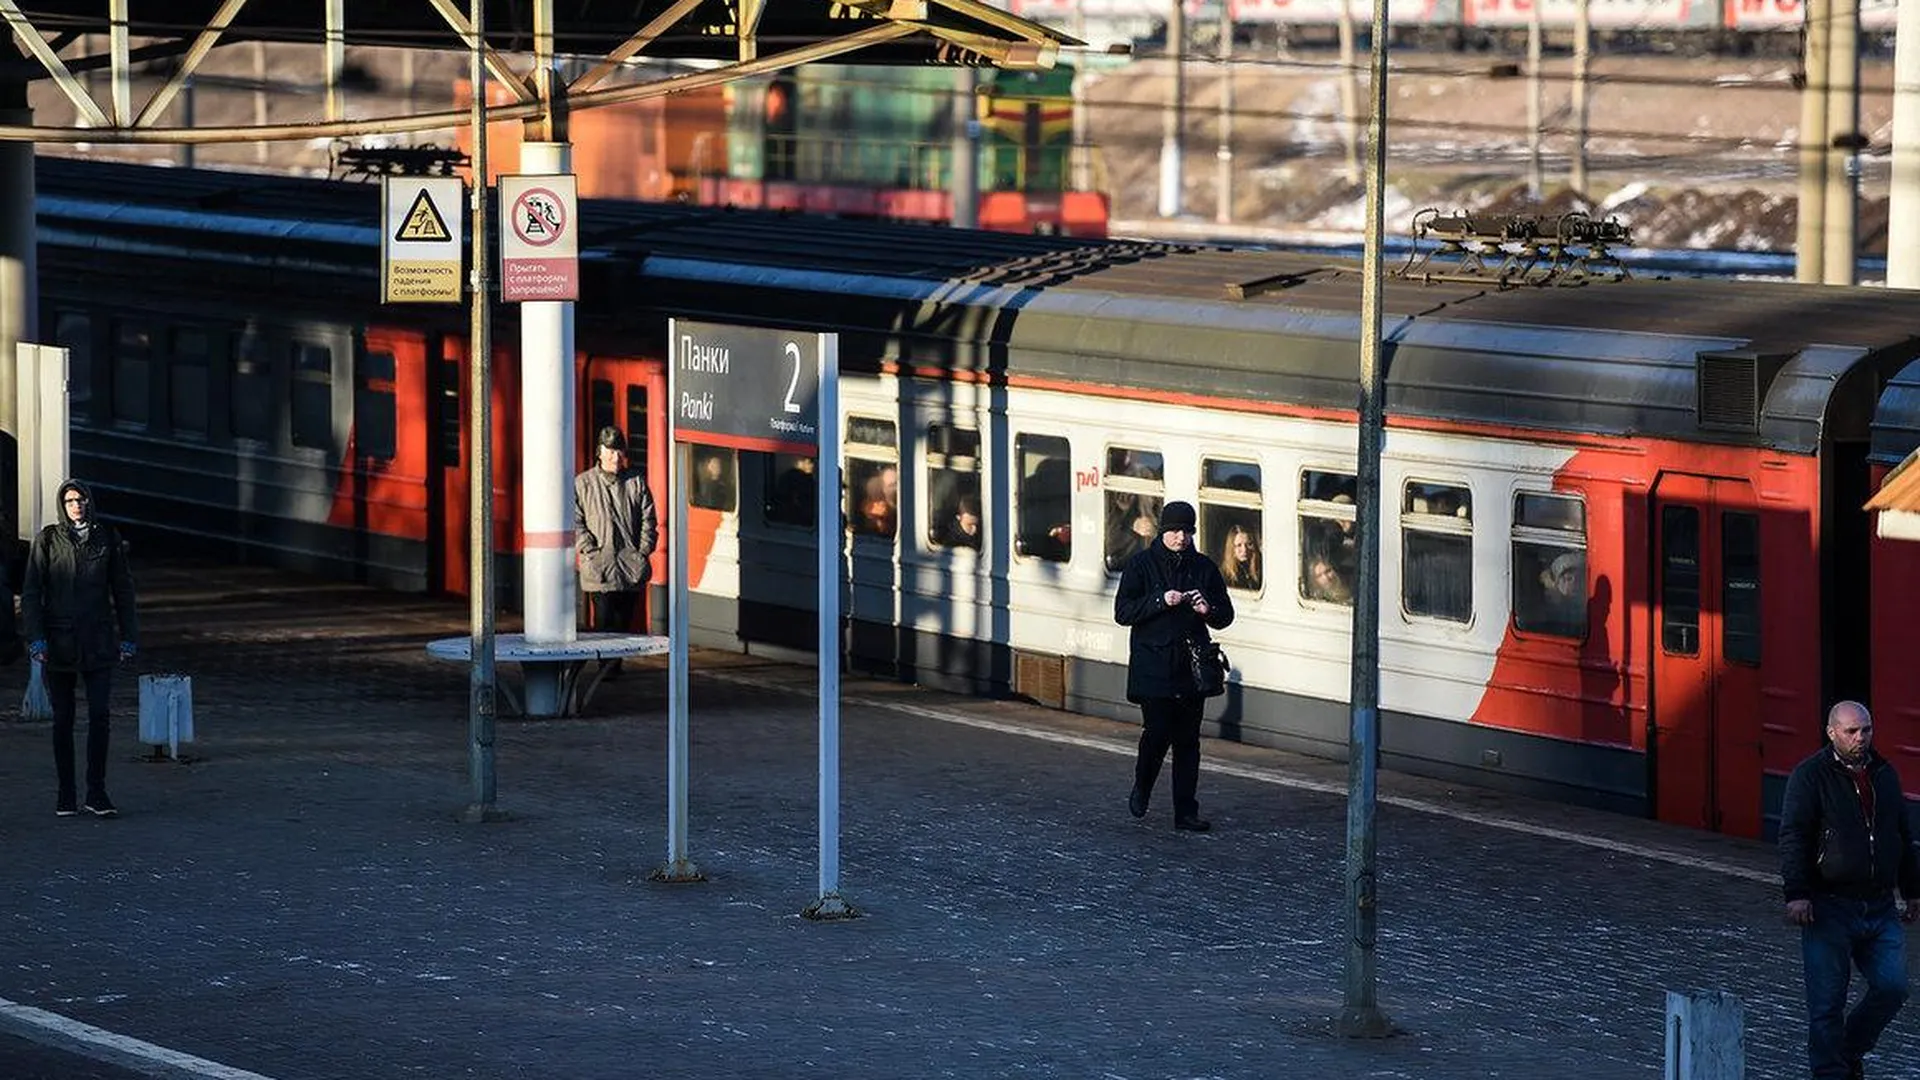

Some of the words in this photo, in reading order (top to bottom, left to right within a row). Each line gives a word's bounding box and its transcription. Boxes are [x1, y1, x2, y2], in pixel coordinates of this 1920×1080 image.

[393, 266, 453, 275] Возможность
[509, 264, 547, 274] Прыгать
[393, 278, 432, 286] падения
[516, 275, 568, 284] платформы
[400, 287, 456, 297] платформы!
[509, 284, 564, 295] запрещено!
[681, 335, 730, 374] Панки
[784, 341, 801, 413] 2
[681, 392, 714, 421] Panki
